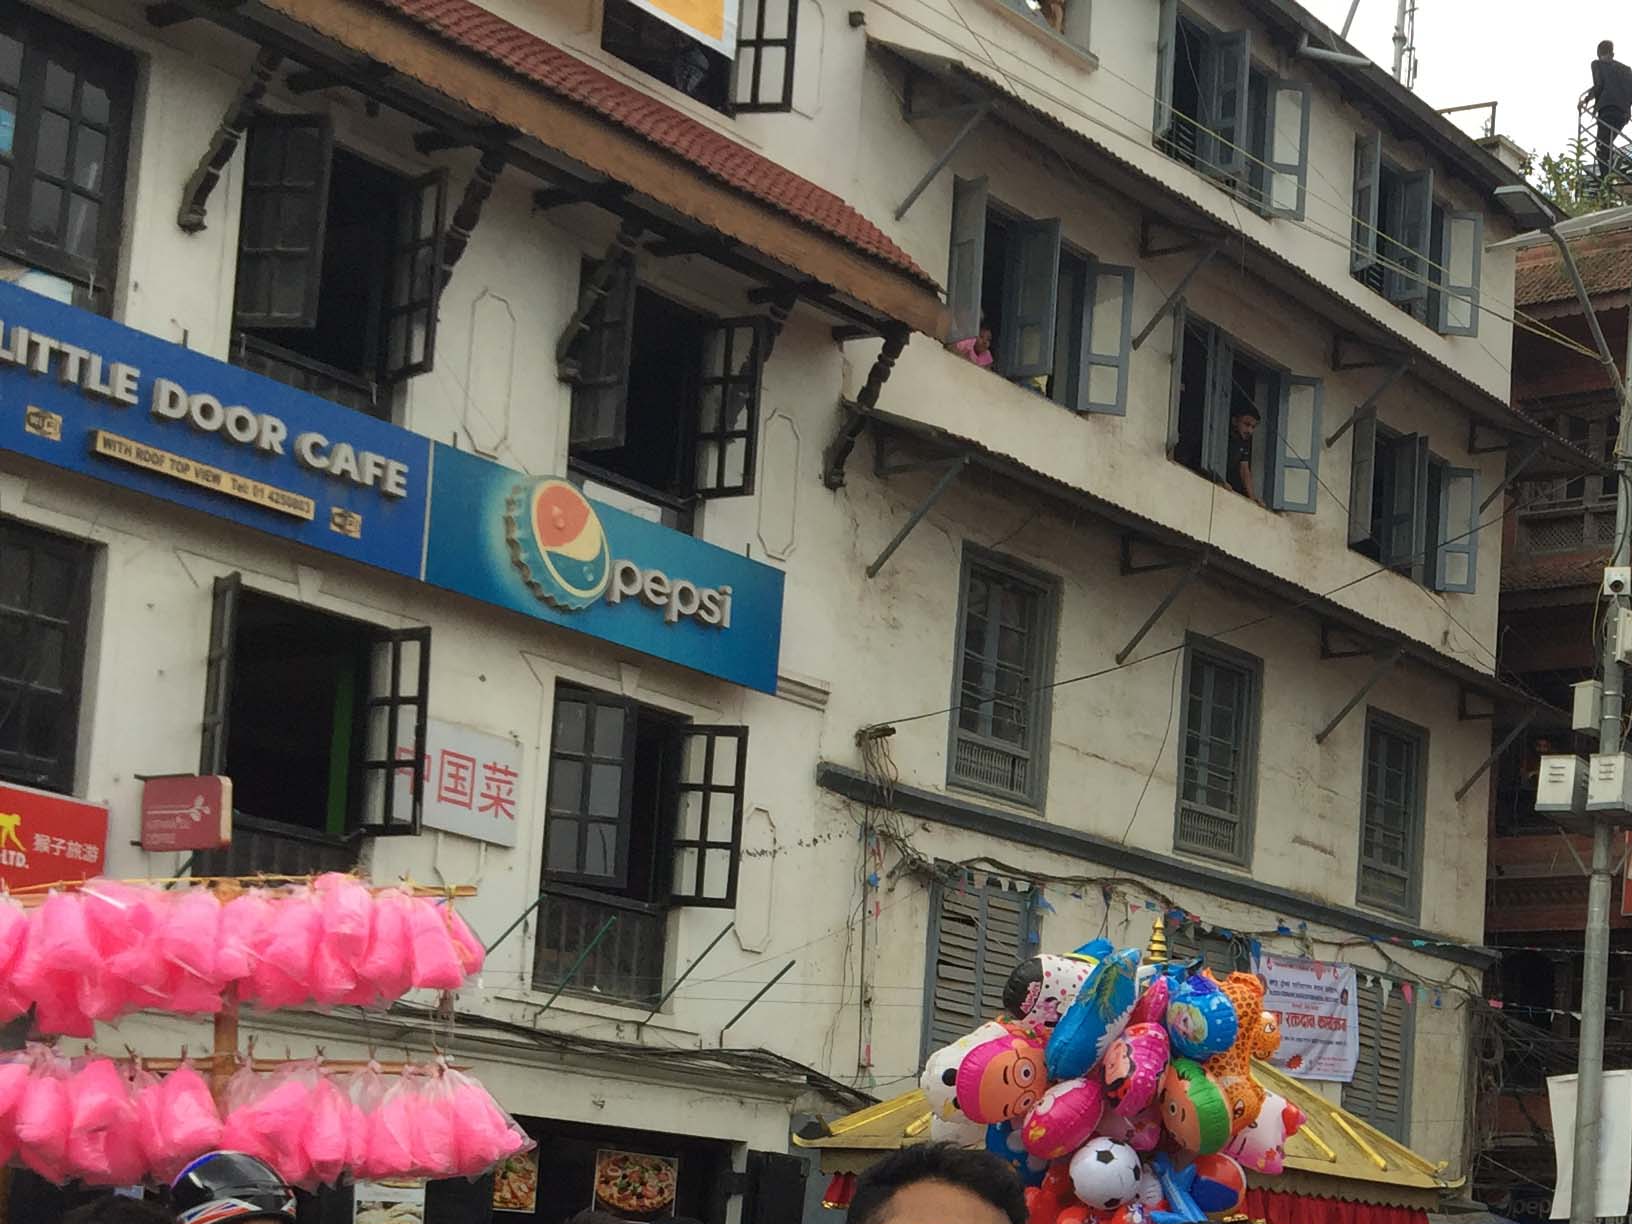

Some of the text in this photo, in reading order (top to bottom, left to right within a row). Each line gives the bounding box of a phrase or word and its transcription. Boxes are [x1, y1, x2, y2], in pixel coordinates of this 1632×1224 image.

[103, 436, 133, 458] WITH
[134, 446, 166, 470] ROOF
[168, 456, 192, 476] TOP
[193, 465, 223, 488] VIEW
[151, 377, 287, 456] DOOR
[294, 432, 409, 498] CAFE
[607, 558, 734, 629] pepsi
